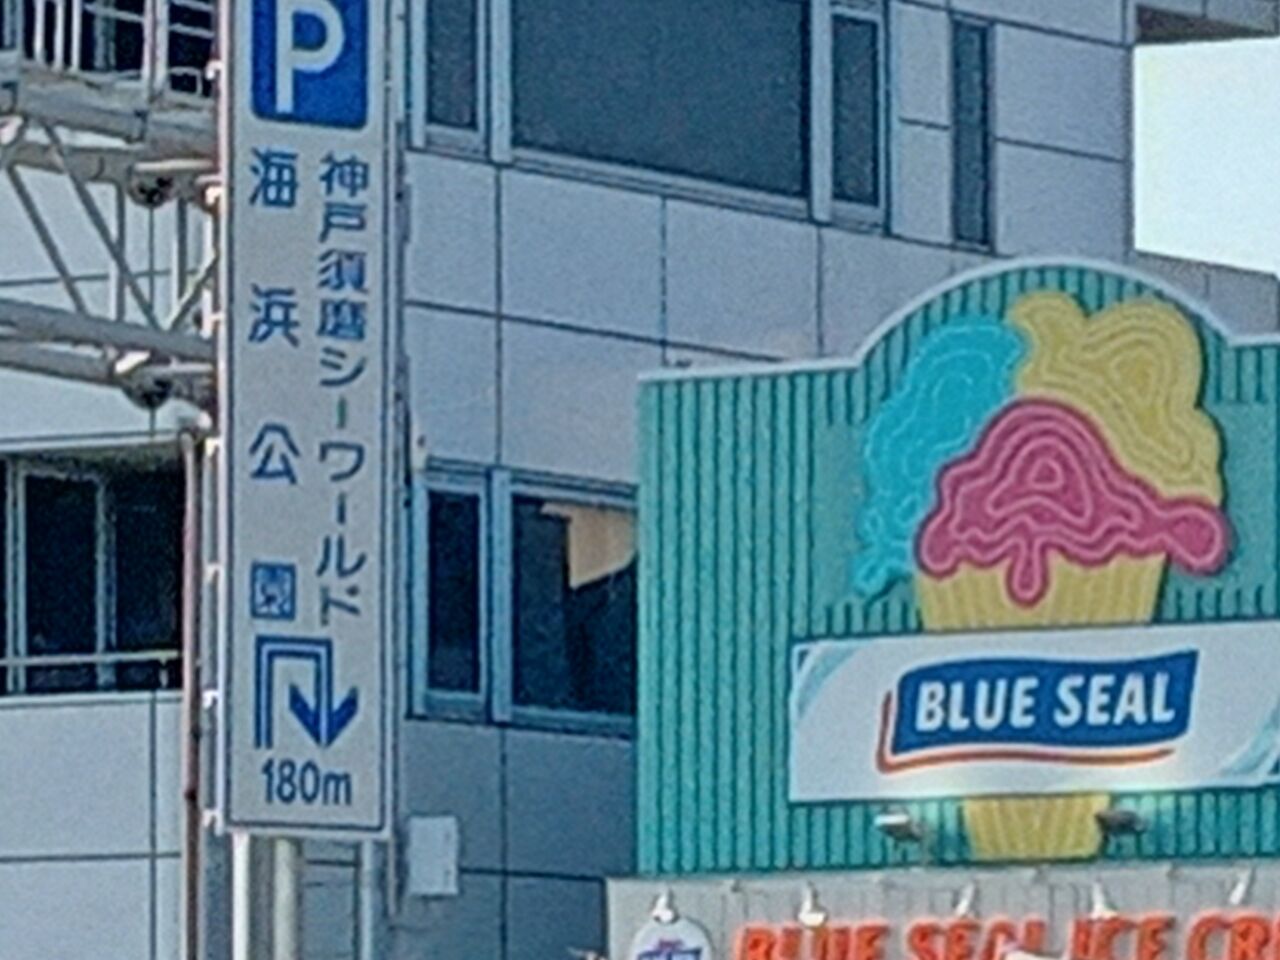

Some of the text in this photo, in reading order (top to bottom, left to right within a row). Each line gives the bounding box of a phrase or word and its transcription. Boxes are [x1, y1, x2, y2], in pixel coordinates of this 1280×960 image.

[274, 0, 346, 114] P
[248, 147, 300, 622] 海浜公園
[316, 150, 371, 625] 神戸須磨シーワールド
[914, 670, 1177, 733] BLUE SEAL
[261, 757, 353, 806] 180m
